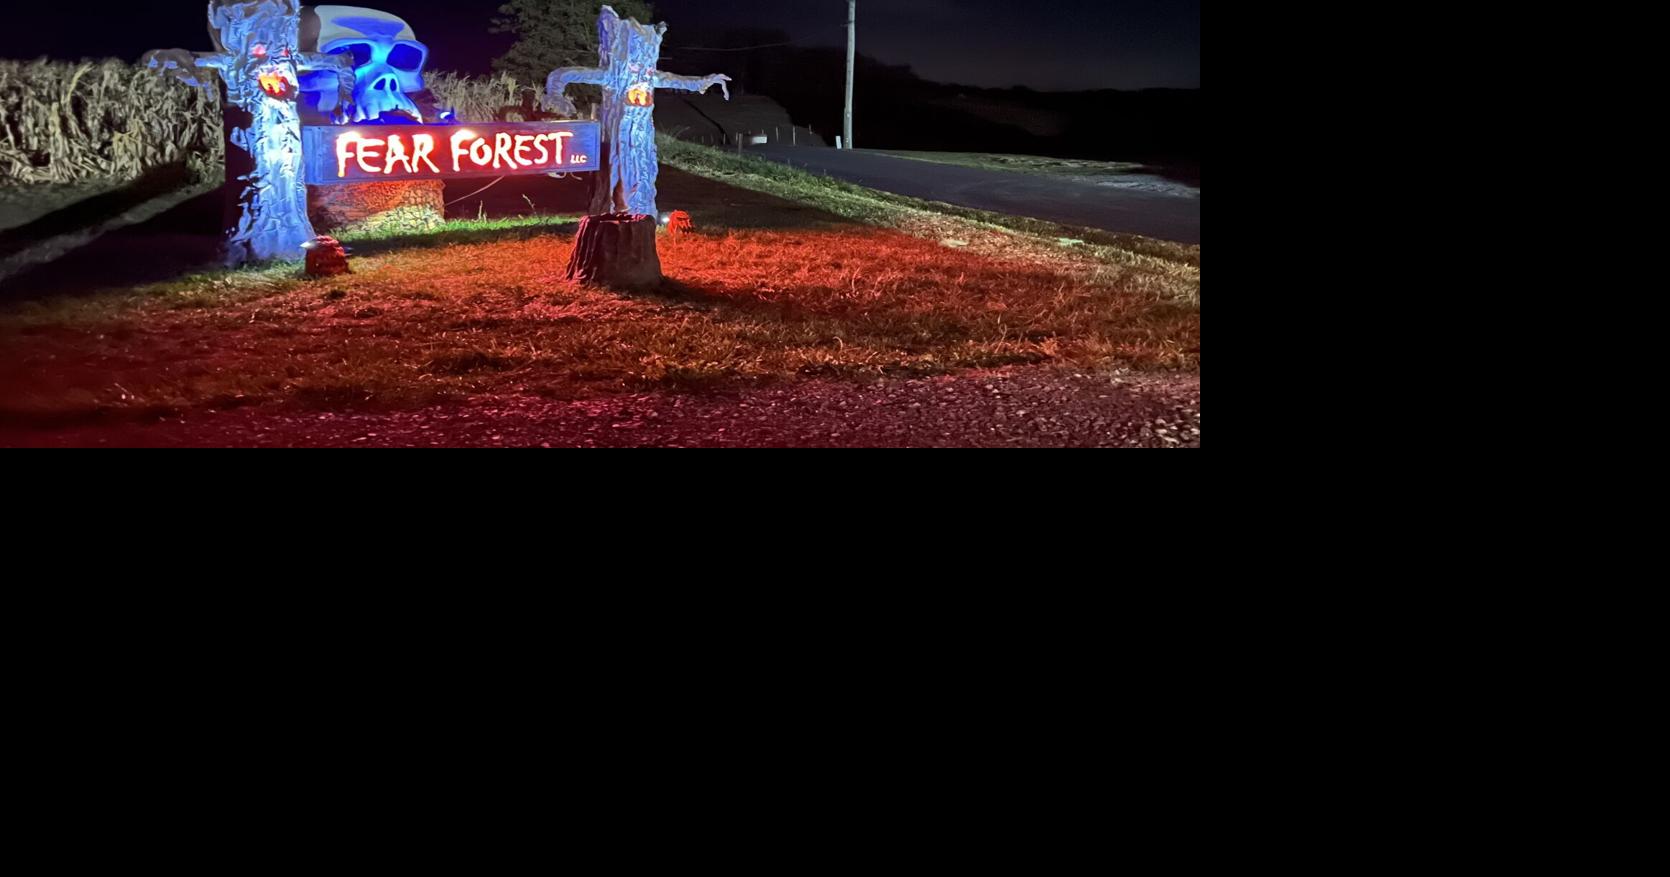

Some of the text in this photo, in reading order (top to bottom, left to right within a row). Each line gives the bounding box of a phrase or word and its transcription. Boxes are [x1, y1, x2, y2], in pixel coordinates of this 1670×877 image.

[336, 129, 588, 177] FEAR FOREST LLC
